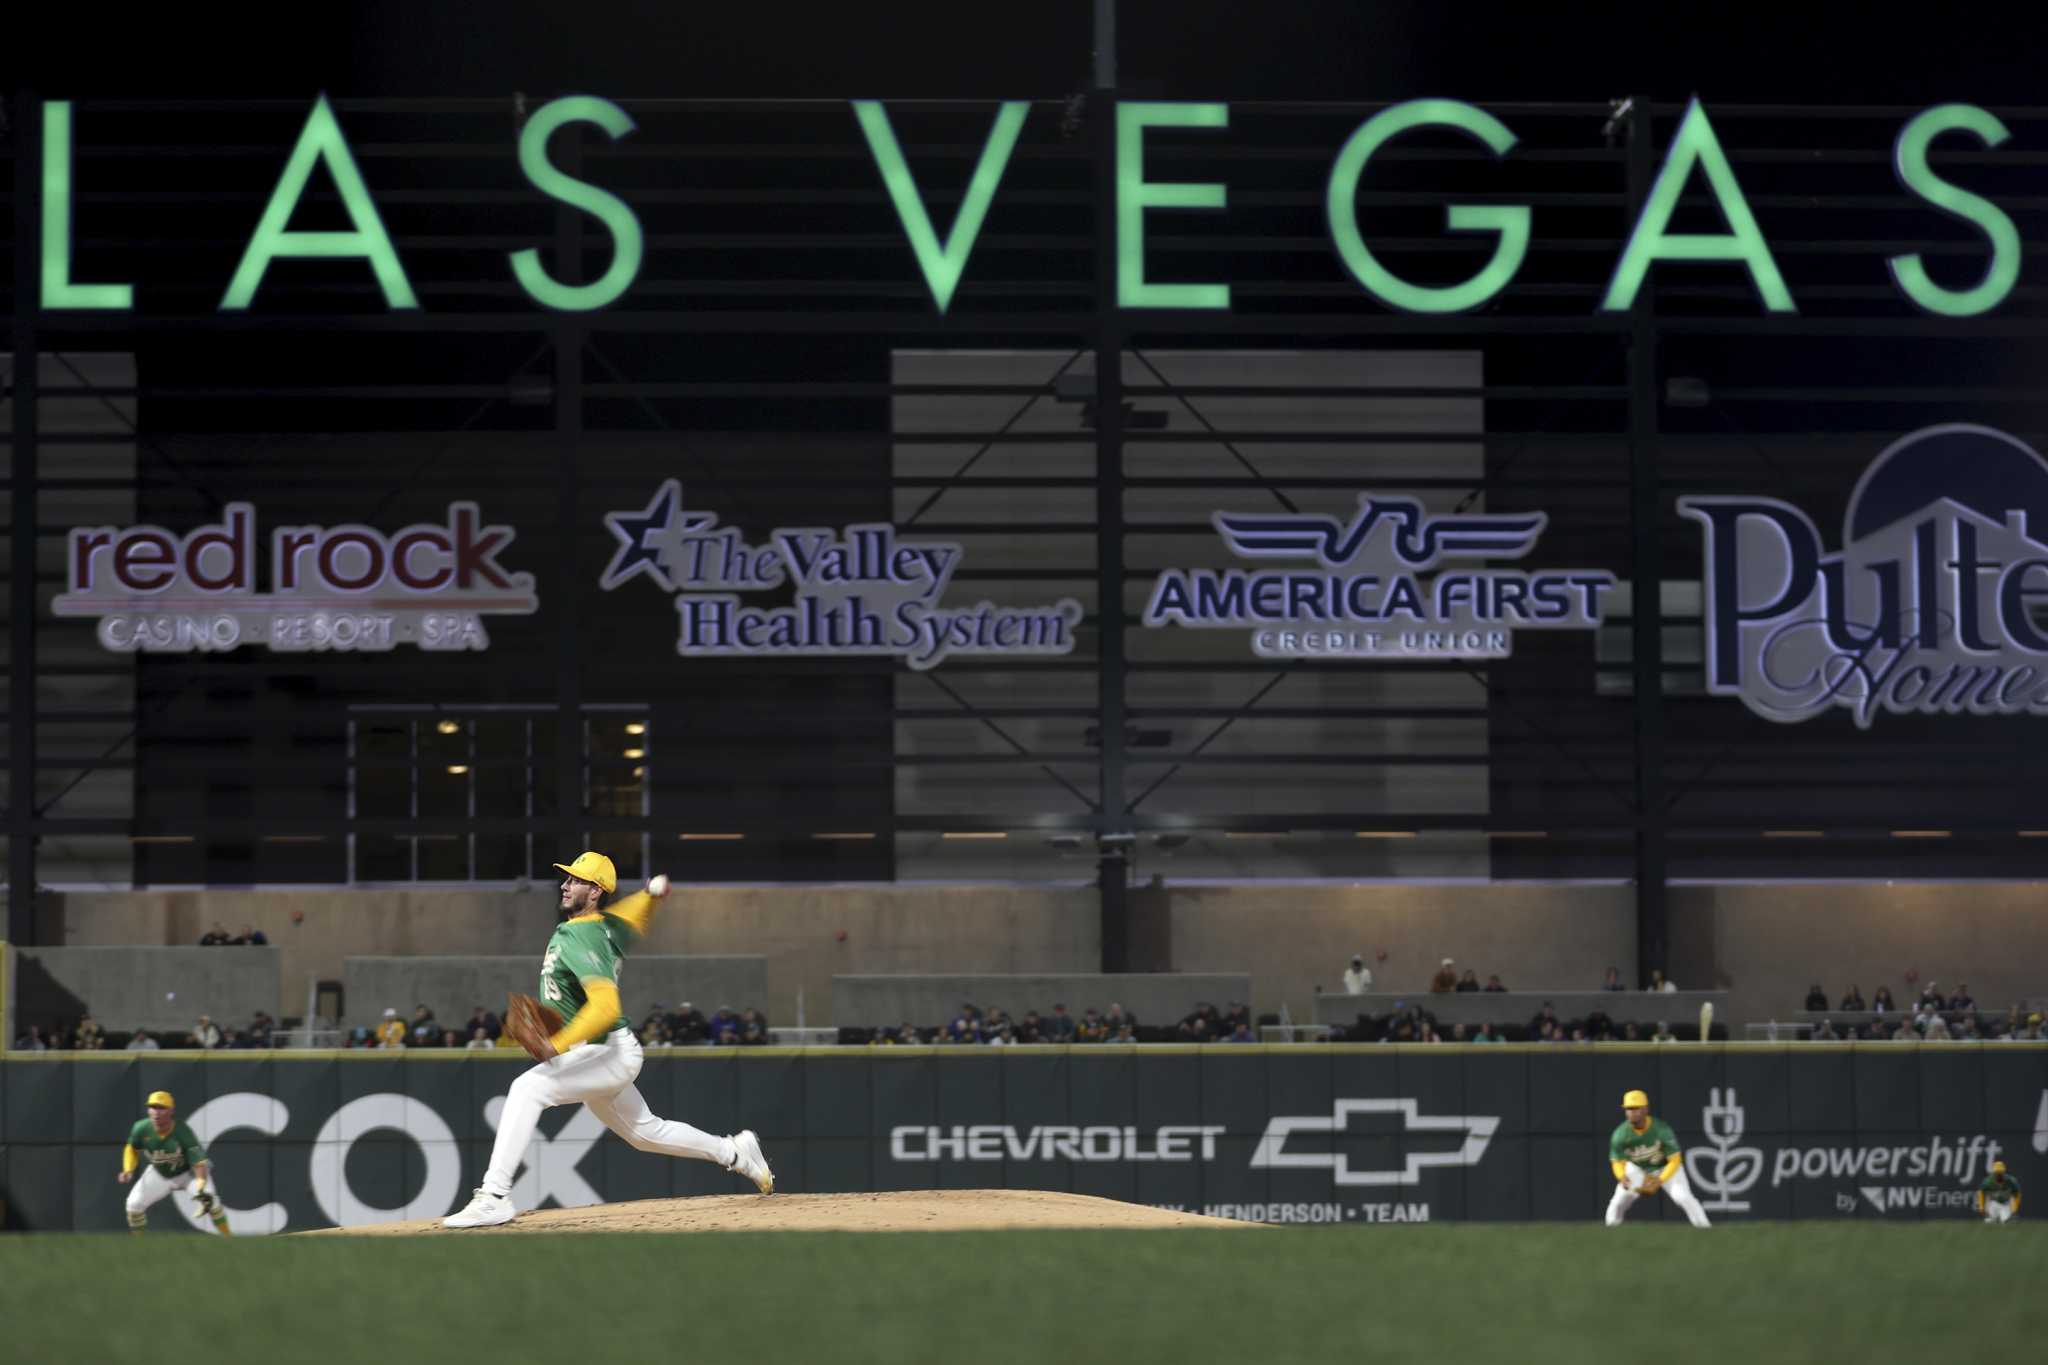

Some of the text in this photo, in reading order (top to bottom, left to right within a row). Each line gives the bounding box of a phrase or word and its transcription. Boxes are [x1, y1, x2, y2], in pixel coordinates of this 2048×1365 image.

[41, 96, 2022, 316] LAS VEGAS
[75, 508, 514, 590] red rock
[682, 531, 955, 597] The Valley
[1152, 575, 1613, 620] AMERICA FIRST
[105, 615, 485, 647] CASINO RESORT SPA
[684, 597, 1070, 662] Health System
[1260, 629, 1508, 650] CREDIT UNION
[172, 1092, 606, 1236] COX
[891, 1125, 1226, 1160] CHEVROLET
[1771, 1135, 2003, 1188] powershift
[1204, 1203, 1341, 1223] HENDERSON
[1363, 1203, 1430, 1223] TEAM
[1836, 1192, 1857, 1213] by
